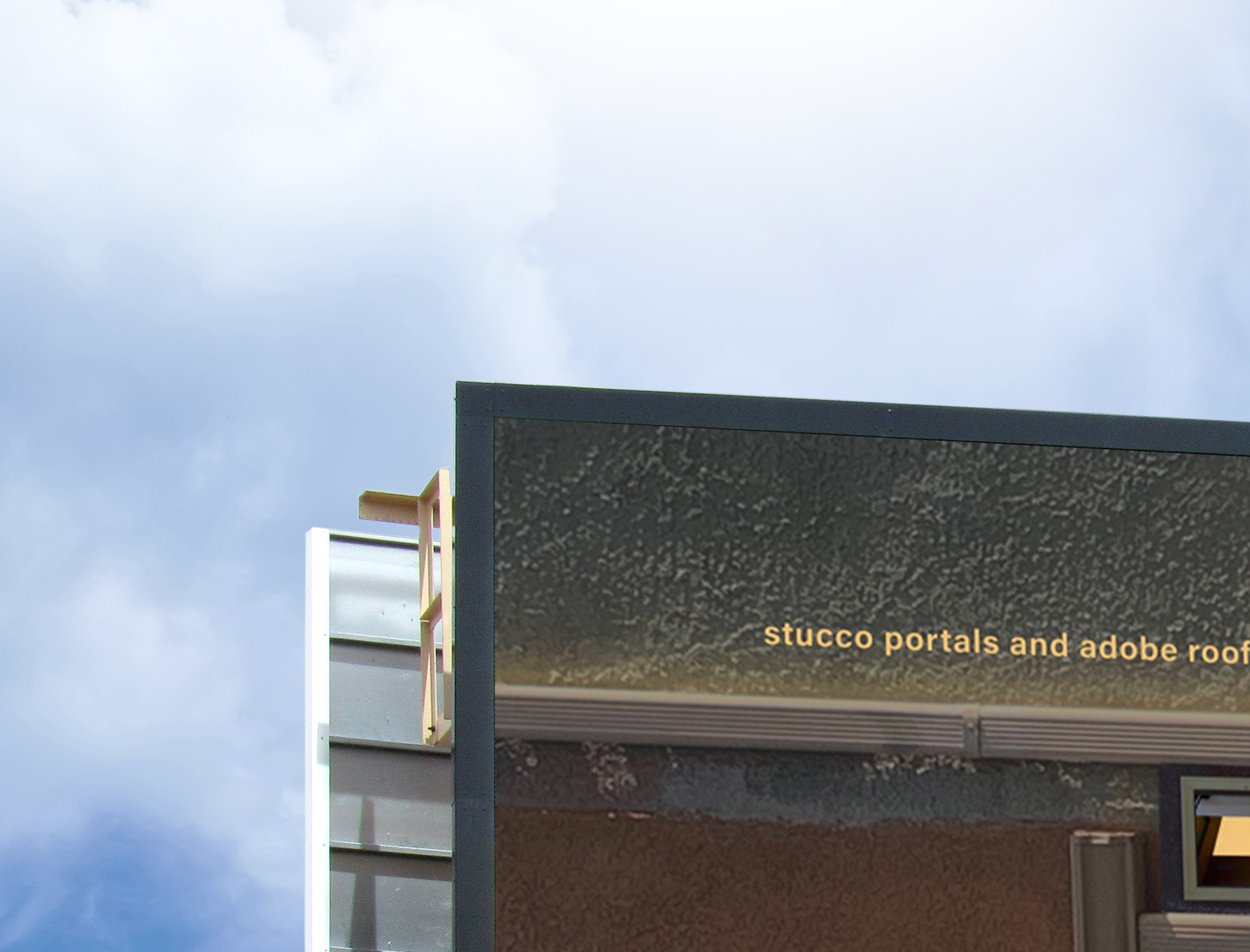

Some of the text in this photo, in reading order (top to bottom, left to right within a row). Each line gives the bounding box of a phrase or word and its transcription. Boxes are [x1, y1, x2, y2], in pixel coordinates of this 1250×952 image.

[763, 622, 874, 650] stucco
[884, 628, 1000, 655] portals
[1009, 632, 1069, 658] and
[1079, 635, 1178, 662] adobe
